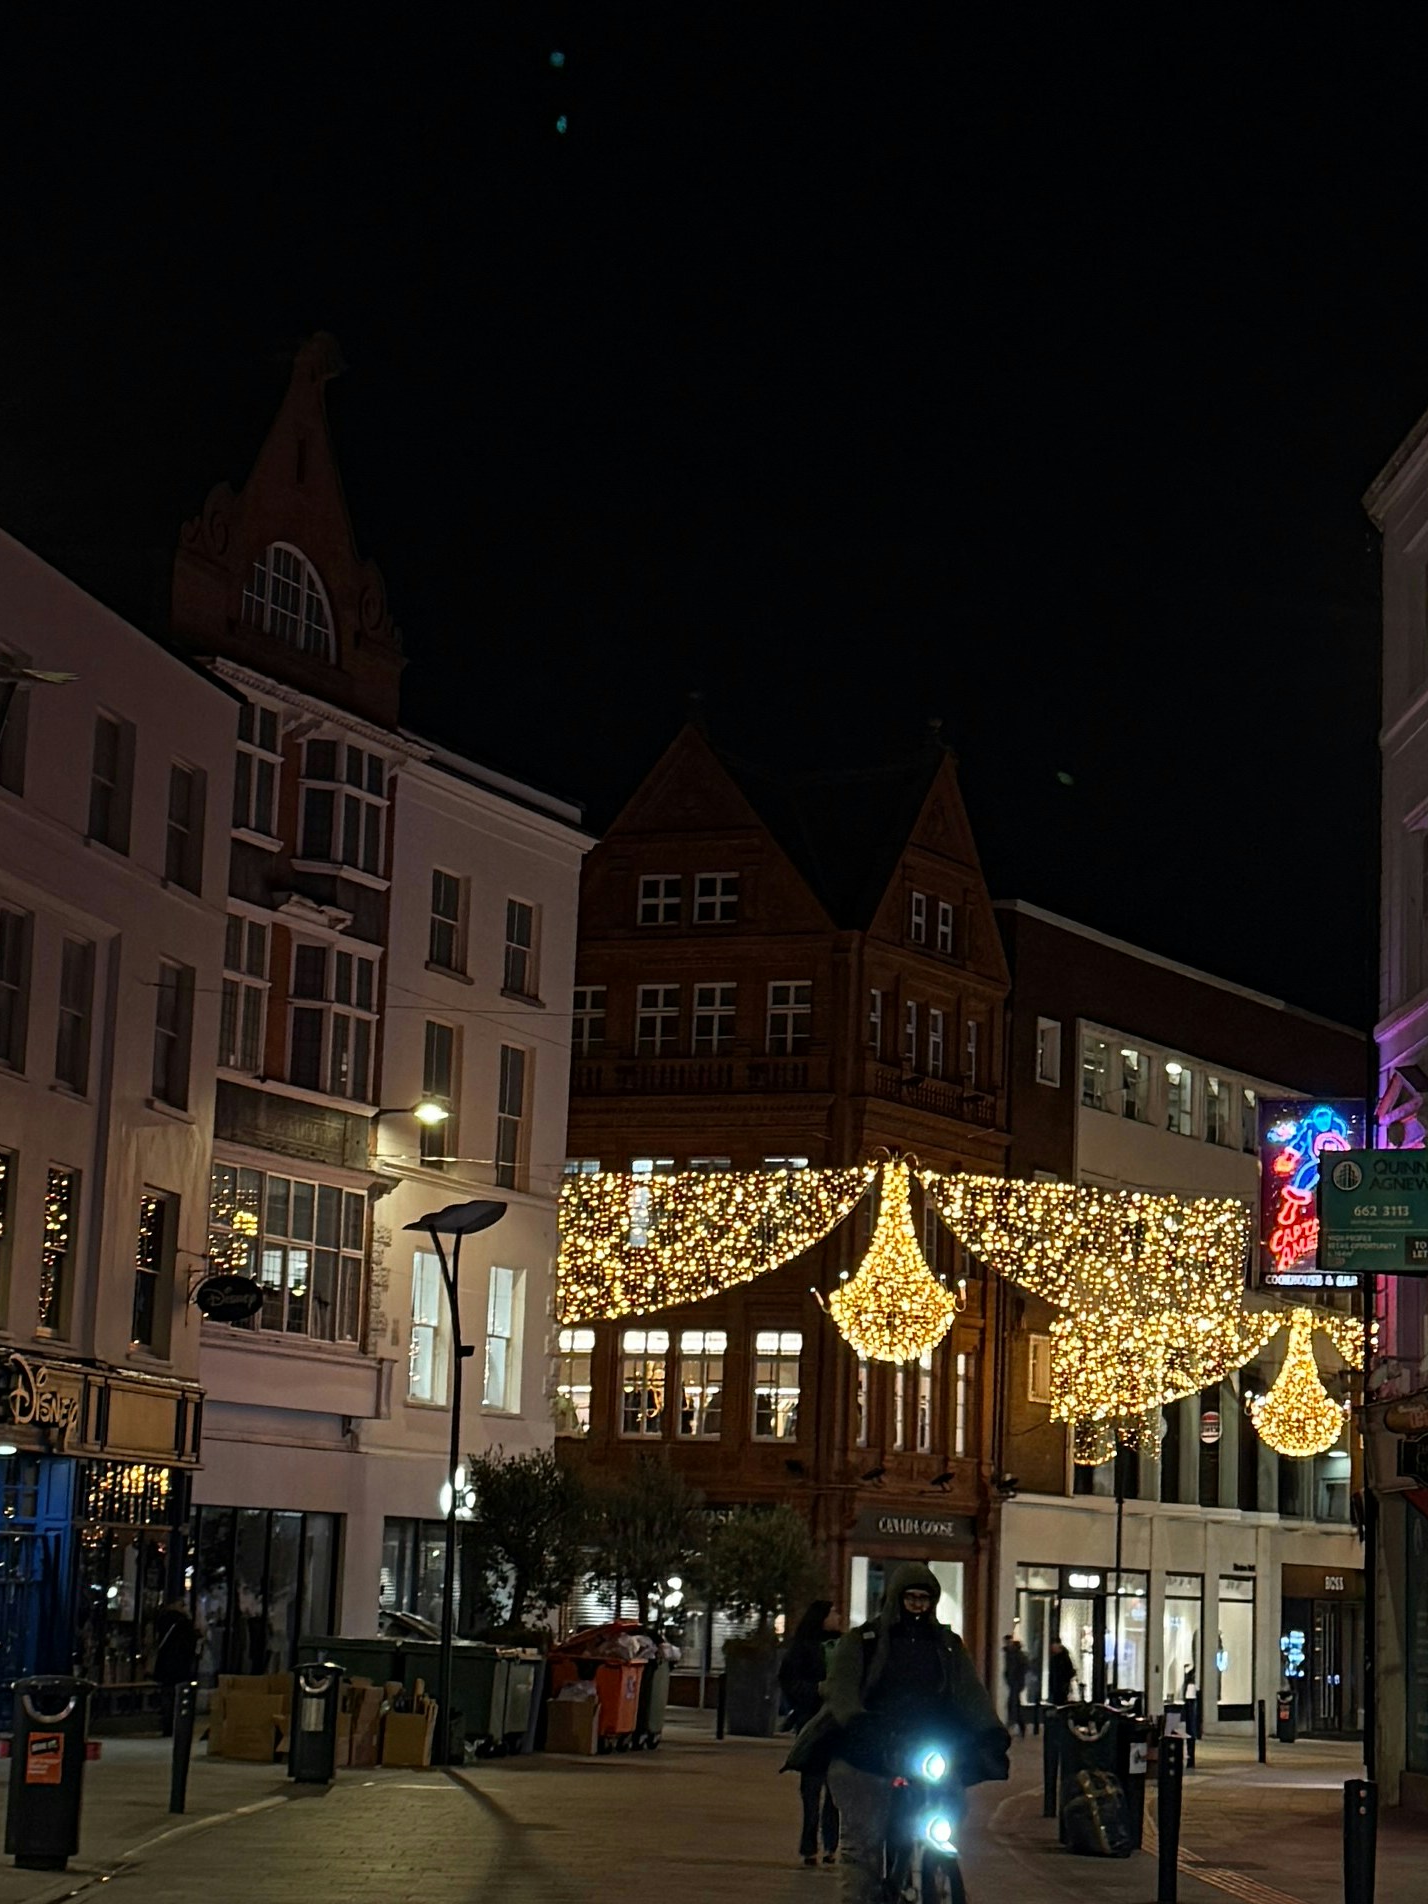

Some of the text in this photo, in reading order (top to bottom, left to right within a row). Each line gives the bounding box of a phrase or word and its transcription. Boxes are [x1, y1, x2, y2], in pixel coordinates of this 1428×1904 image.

[1374, 1159, 1428, 1175] QUINN
[1354, 1205, 1409, 1216] 662 3113
[1414, 1241, 1427, 1249] TO
[1413, 1250, 1428, 1259] LET
